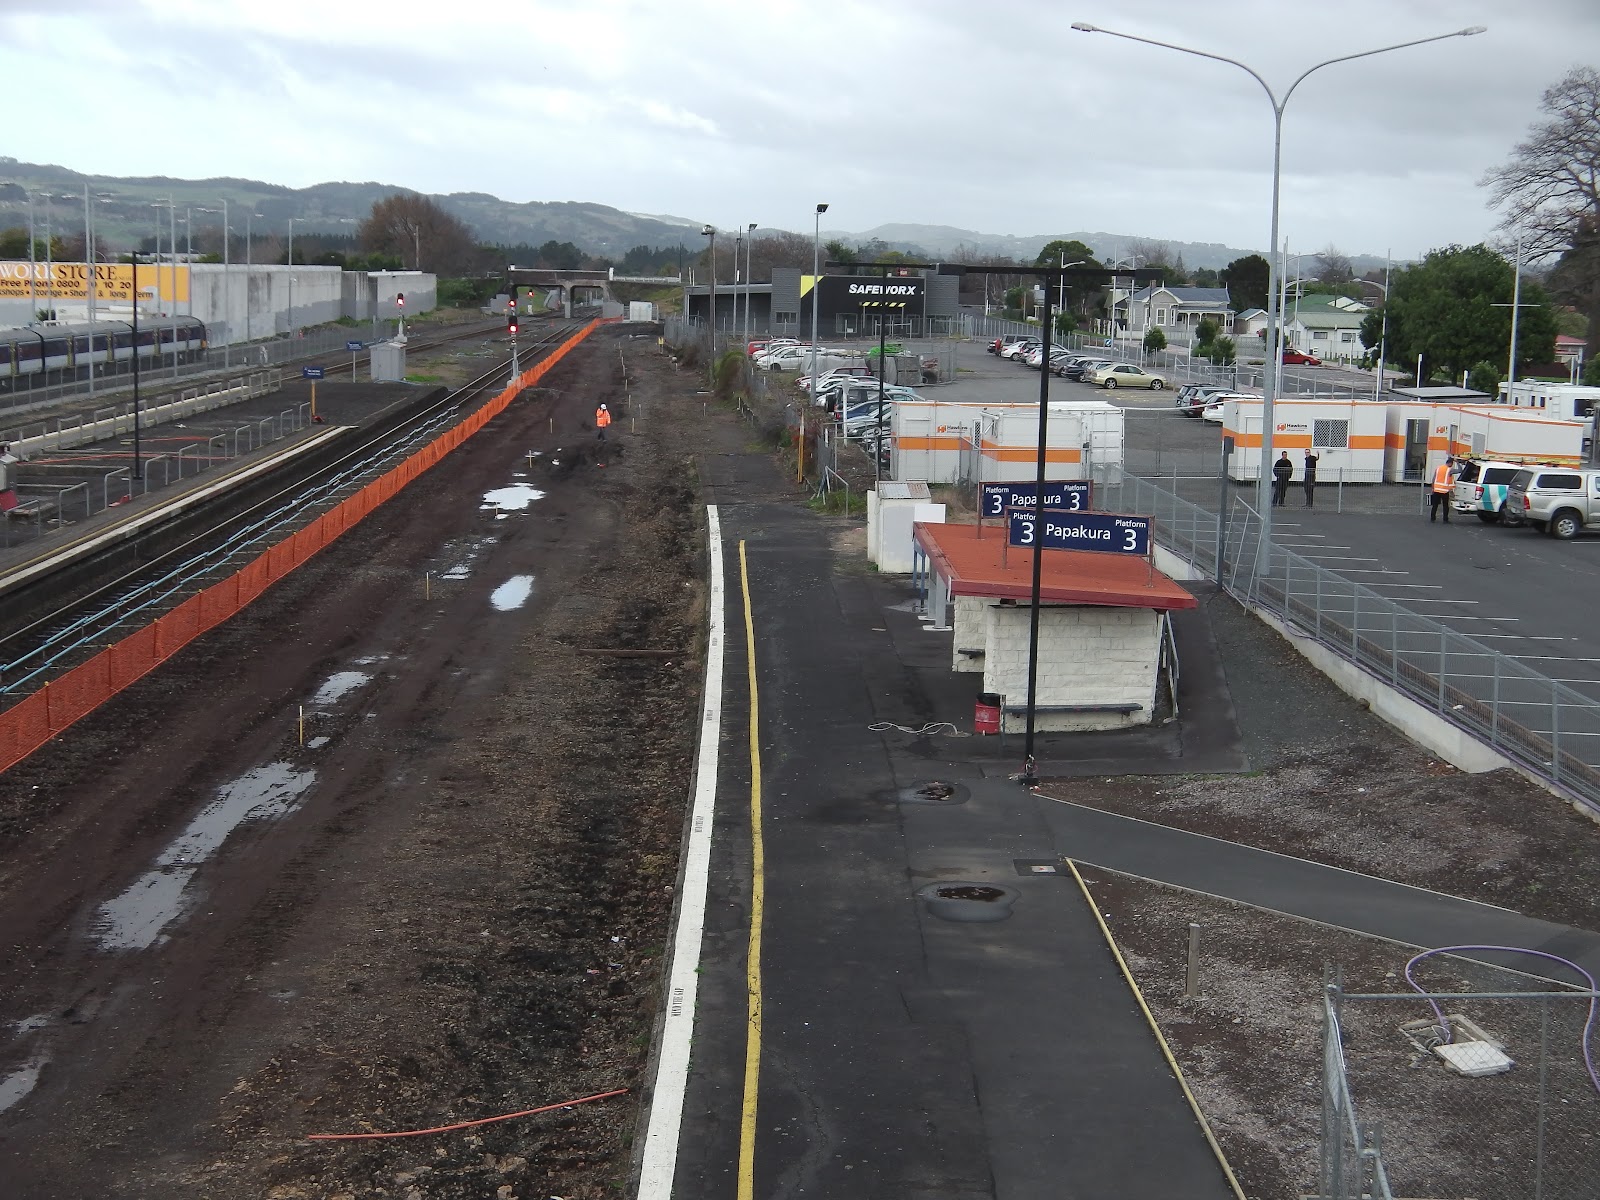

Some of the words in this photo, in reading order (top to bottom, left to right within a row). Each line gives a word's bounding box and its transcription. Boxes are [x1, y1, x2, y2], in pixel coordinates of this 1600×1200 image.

[1, 280, 21, 288] Free
[57, 280, 79, 289] 0800
[103, 281, 113, 289] 10
[120, 281, 132, 289] 20
[985, 486, 1010, 494] Platform
[1063, 484, 1088, 492] Platform
[991, 494, 1003, 514] 3
[1011, 493, 1061, 508] Papaura
[1069, 492, 1081, 511] 3
[1013, 512, 1036, 522] Platfor
[1115, 519, 1147, 529] Platform
[1020, 521, 1035, 544] 3
[1046, 523, 1111, 541] Papakura
[1122, 528, 1138, 551] 3
